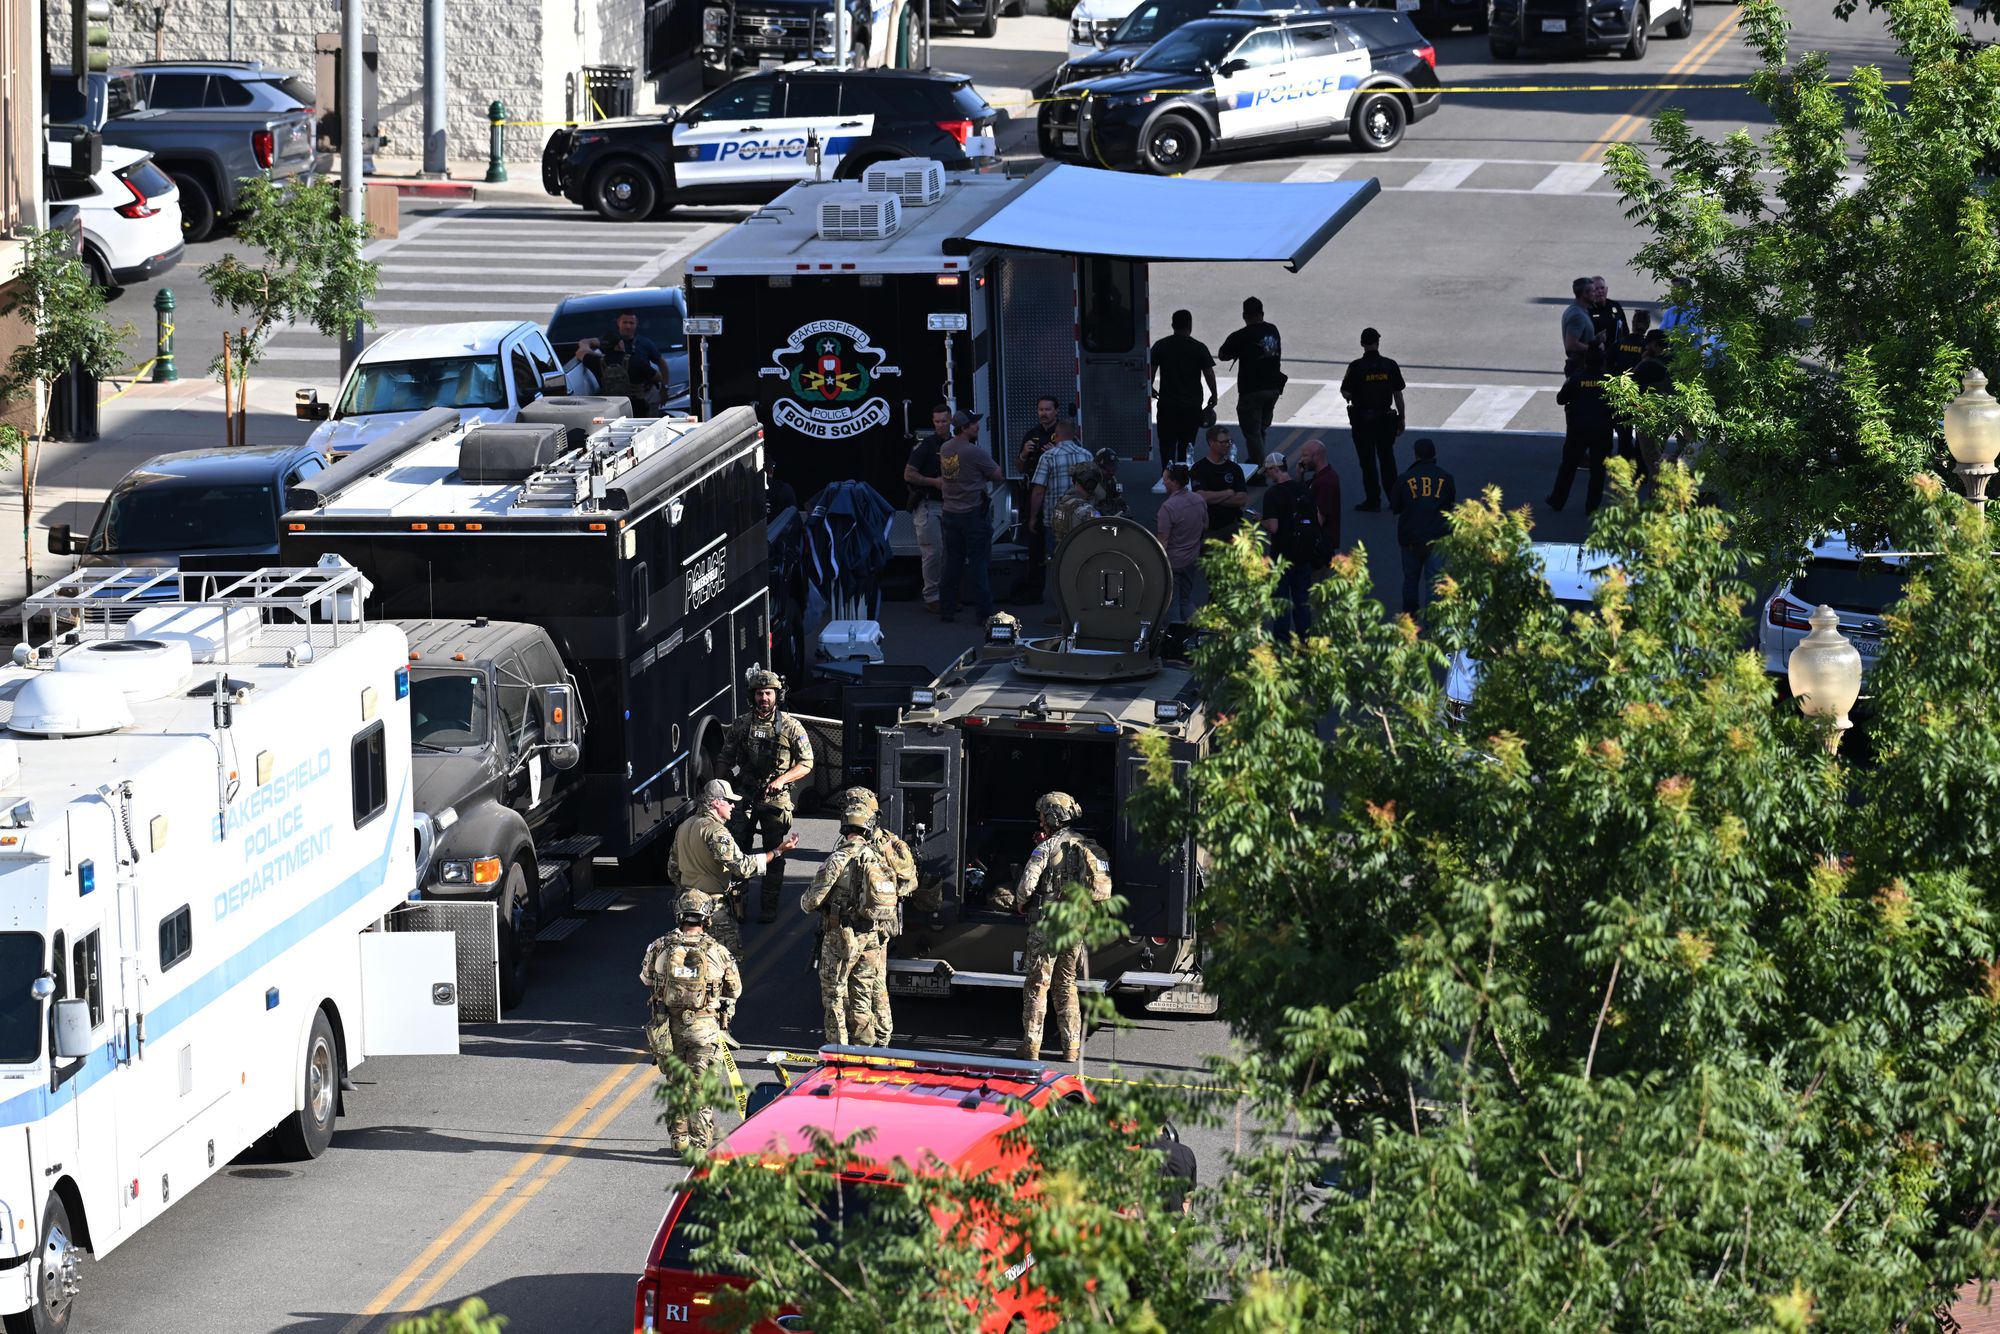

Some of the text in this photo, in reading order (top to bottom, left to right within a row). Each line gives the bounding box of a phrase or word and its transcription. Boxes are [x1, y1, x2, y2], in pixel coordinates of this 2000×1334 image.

[1255, 76, 1335, 106] POLICE
[790, 321, 867, 345] BAKERSFIELD
[1620, 344, 1642, 353] POLICE
[784, 409, 879, 437] BOMB SQUAD
[814, 408, 848, 419] POLICE
[1407, 476, 1445, 499] FBI
[684, 546, 726, 615] POLICE
[754, 730, 766, 739] FBI
[211, 748, 331, 843] BAKERSFIELD
[244, 804, 304, 863] POLICE
[213, 824, 334, 922] DEPARTMENT
[724, 1052, 736, 1073] CROSS
